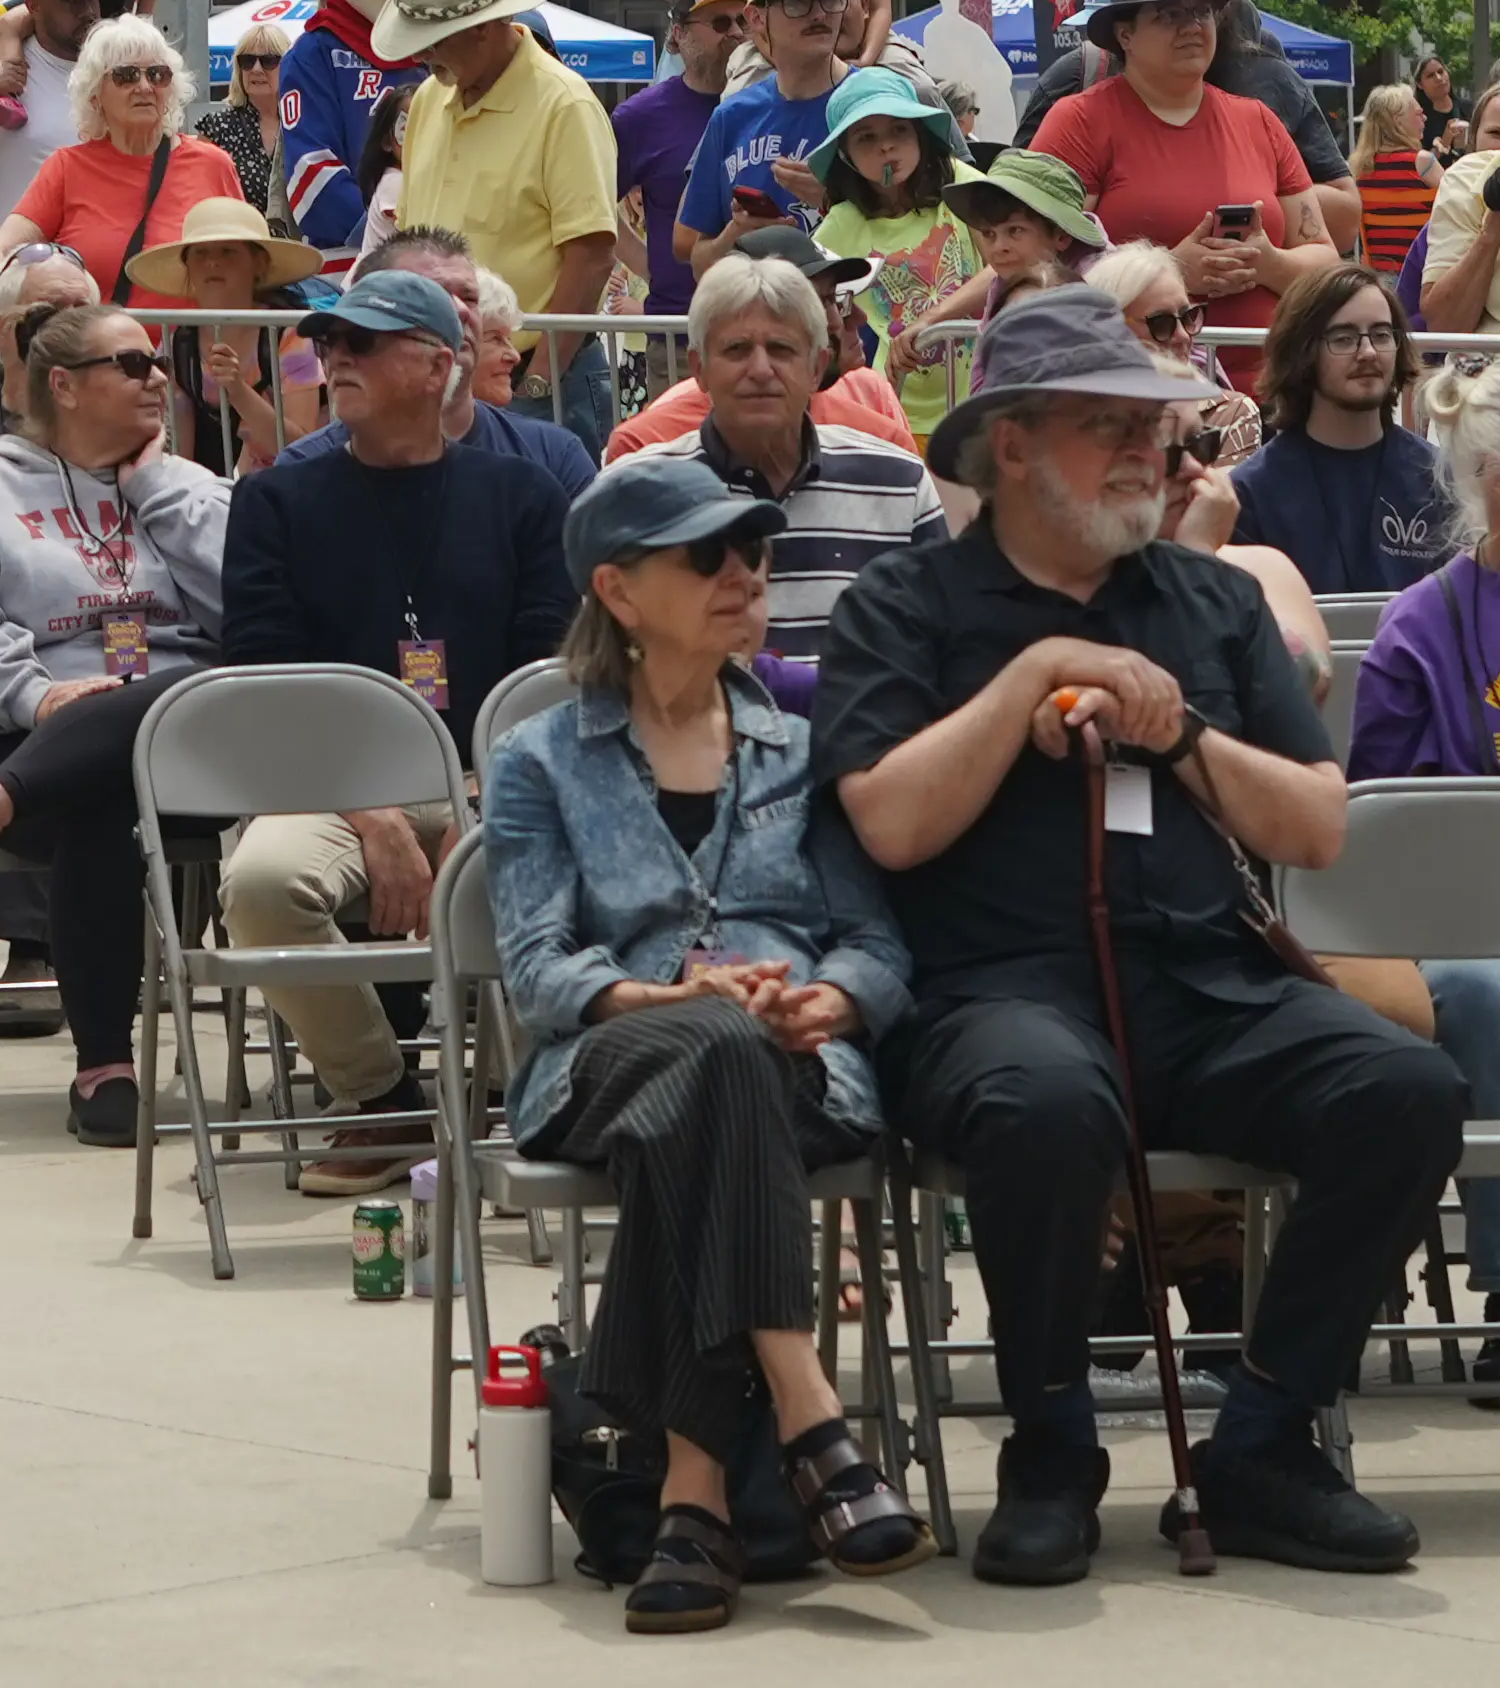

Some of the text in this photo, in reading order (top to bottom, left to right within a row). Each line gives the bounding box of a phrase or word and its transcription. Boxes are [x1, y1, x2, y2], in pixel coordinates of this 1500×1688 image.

[724, 134, 782, 183] BLUE
[77, 594, 113, 609] FIRE
[48, 615, 84, 633] CITY
[116, 654, 138, 665] VIP
